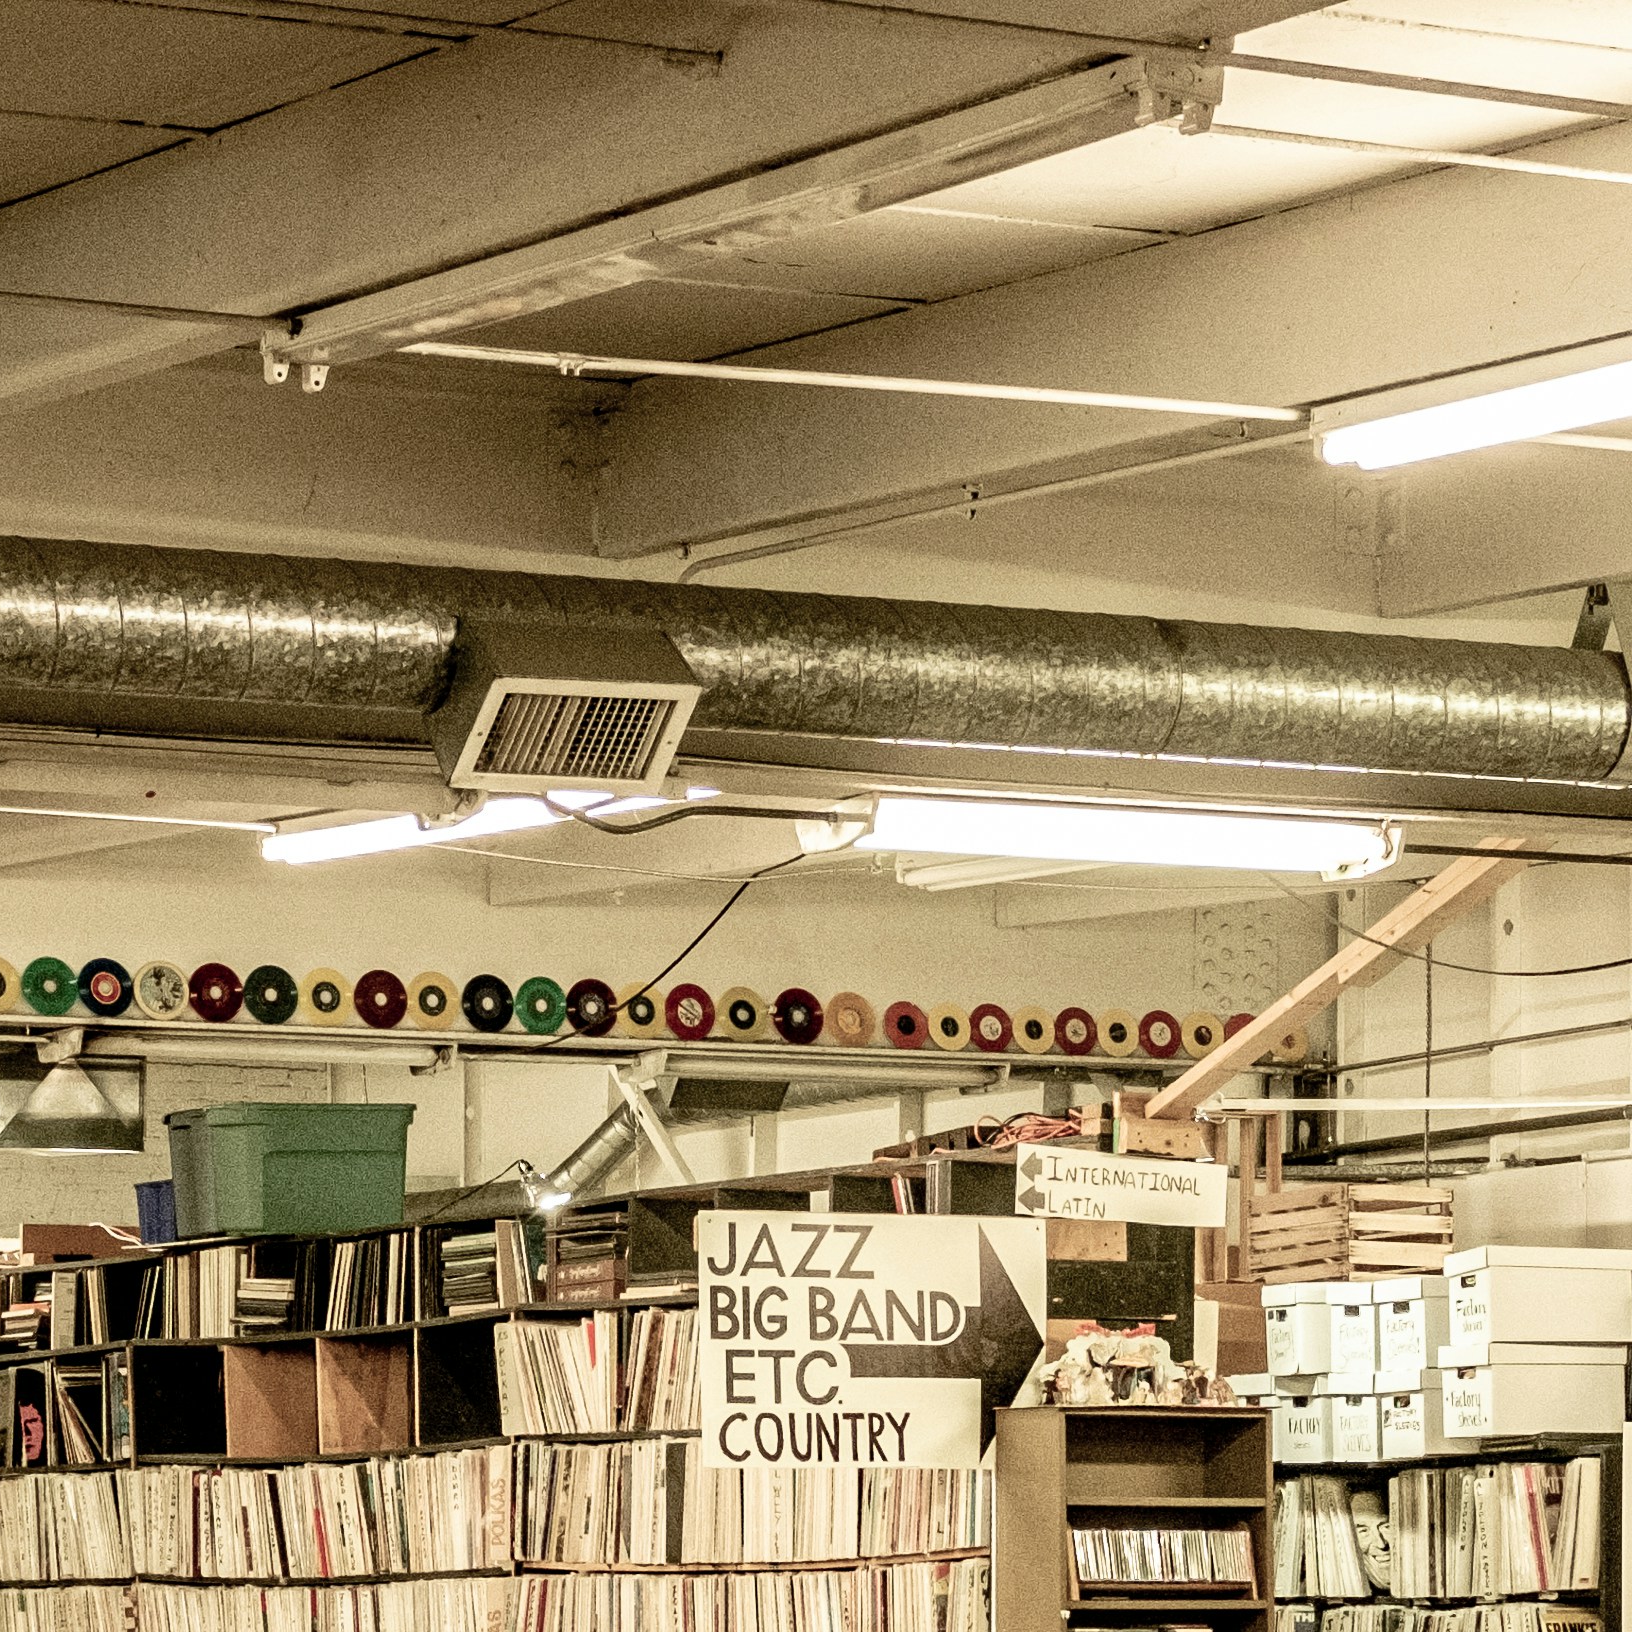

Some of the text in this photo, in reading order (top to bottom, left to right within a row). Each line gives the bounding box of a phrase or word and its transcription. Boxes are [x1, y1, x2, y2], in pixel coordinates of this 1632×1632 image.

[1045, 1155, 1202, 1196] INTERNATIONAL
[1047, 1189, 1106, 1219] LATIN
[708, 1222, 874, 1278] JAZZ
[709, 1286, 965, 1343] BIG BAND
[724, 1348, 843, 1406] ETC.
[719, 1412, 911, 1463] COUNTRY
